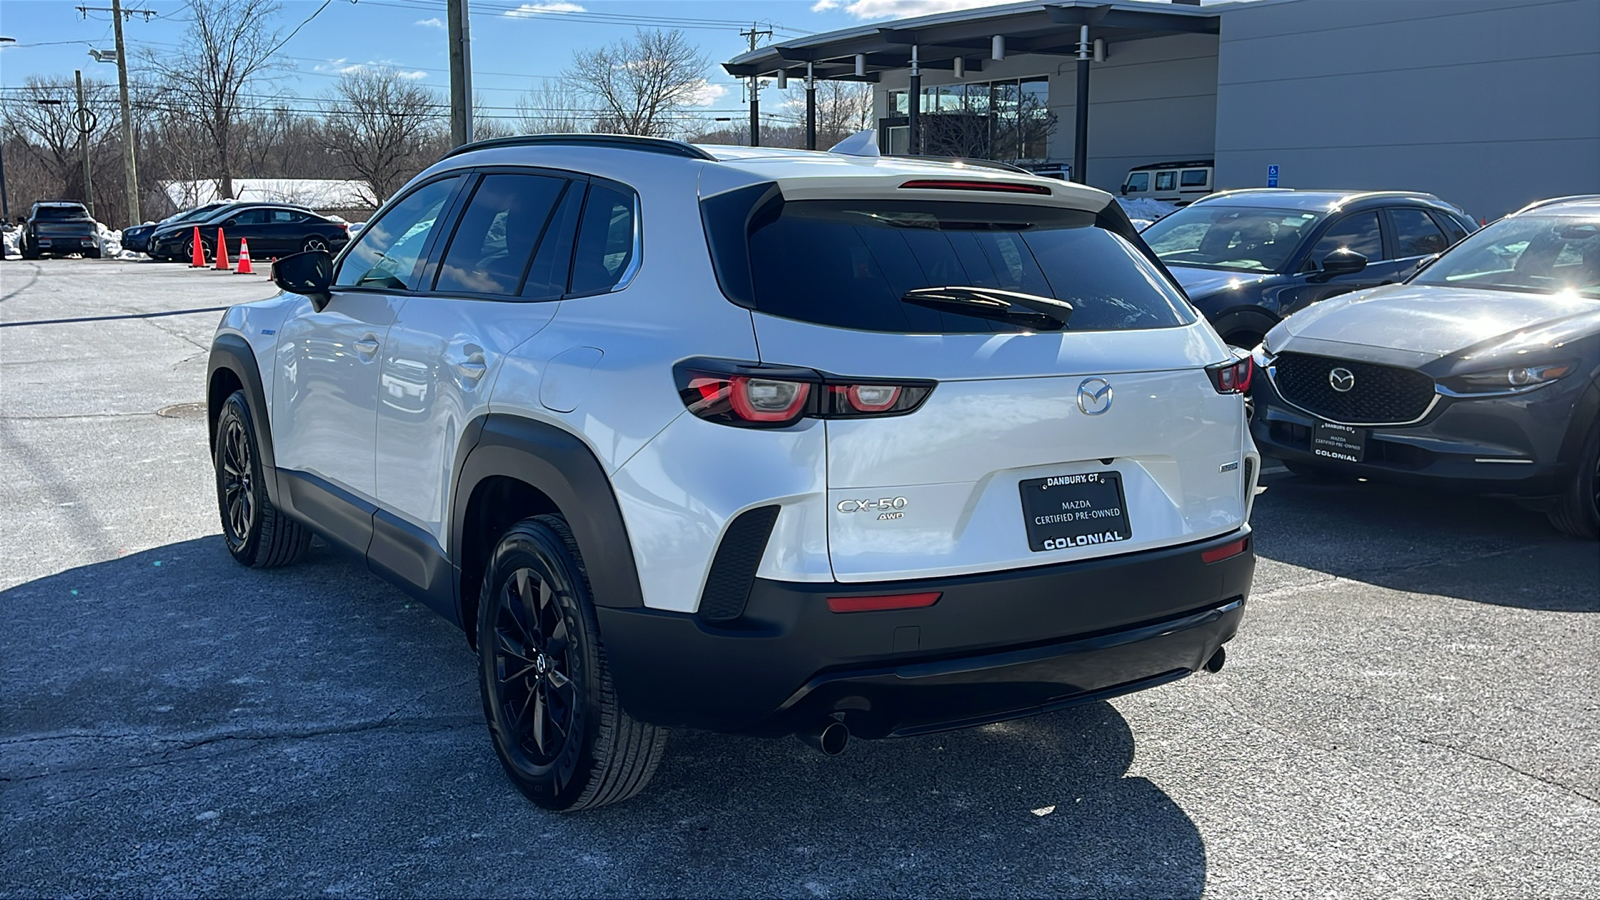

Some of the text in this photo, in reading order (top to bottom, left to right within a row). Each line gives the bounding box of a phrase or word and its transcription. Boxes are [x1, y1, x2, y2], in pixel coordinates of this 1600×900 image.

[1315, 438, 1361, 451] CERTIFIED PRE-OWNED
[1330, 435, 1347, 443] MAZDA
[1315, 449, 1358, 462] COLONIAL
[1047, 473, 1099, 487] DANBURY, CT
[836, 496, 908, 514] CX-50
[1061, 500, 1092, 510] MAZDA
[877, 512, 905, 521] AWD
[1035, 508, 1120, 525] CERTIFIED PRE-OWNED
[1043, 531, 1123, 550] COLONIAL
